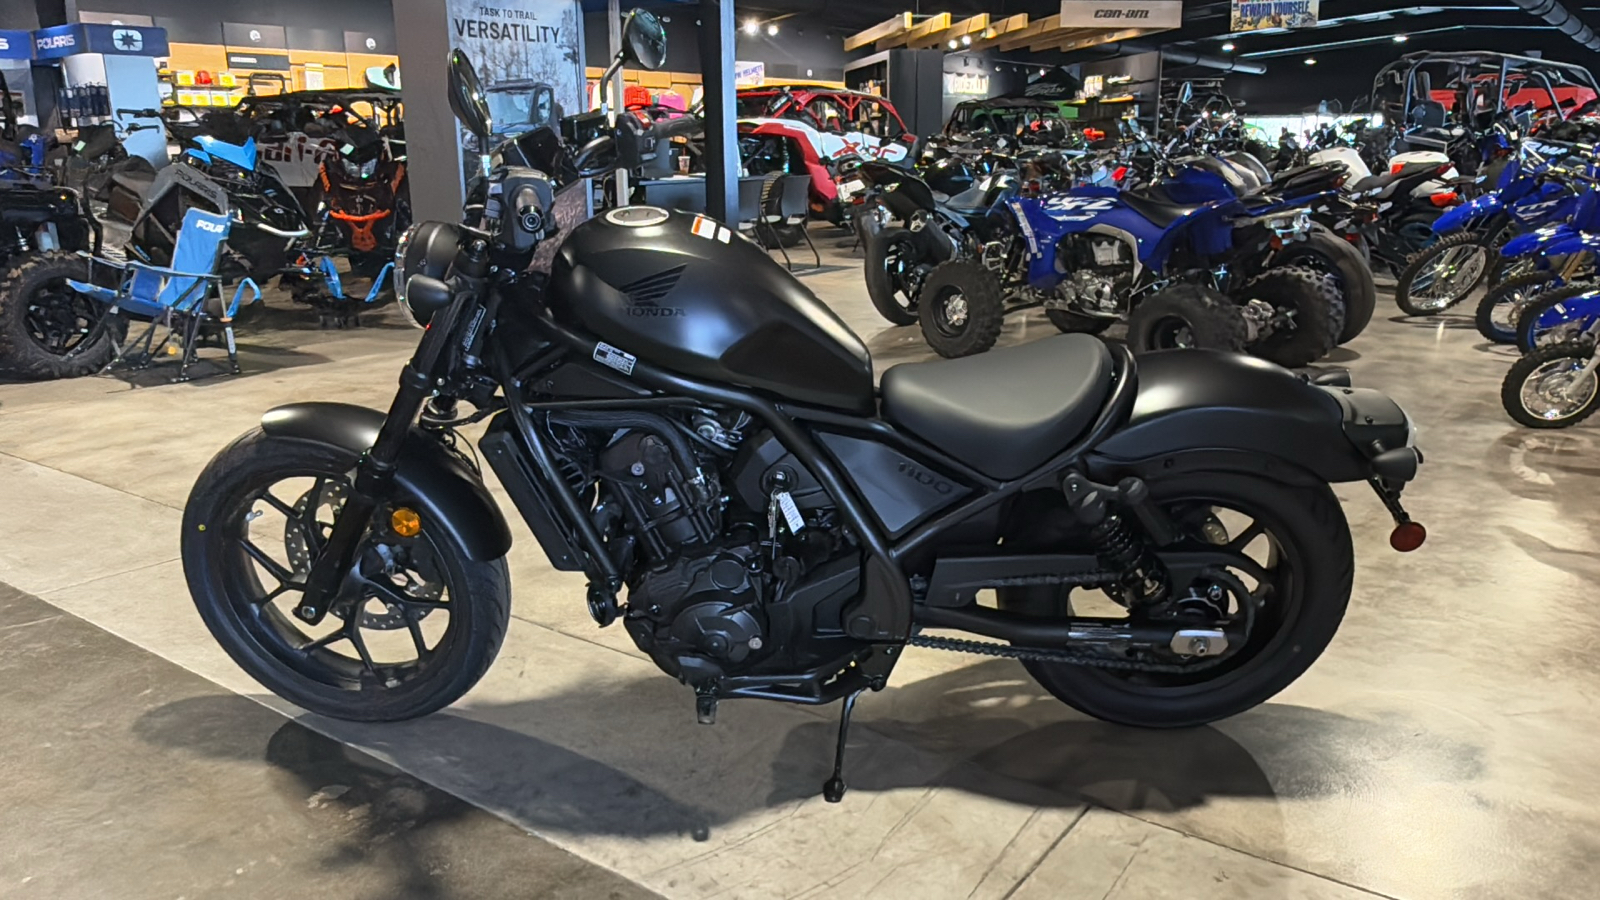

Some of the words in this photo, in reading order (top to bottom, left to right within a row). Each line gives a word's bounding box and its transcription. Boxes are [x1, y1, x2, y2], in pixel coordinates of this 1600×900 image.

[480, 7, 500, 18] TASK
[503, 9, 513, 19] TO
[515, 10, 537, 20] TRAIL
[1241, 3, 1272, 17] REWARD
[1274, 1, 1310, 15] YOURSELF
[454, 19, 560, 43] VERSATILITY
[37, 34, 75, 50] POLARIS
[175, 169, 218, 199] POLARIS
[621, 306, 687, 317] HONDA
